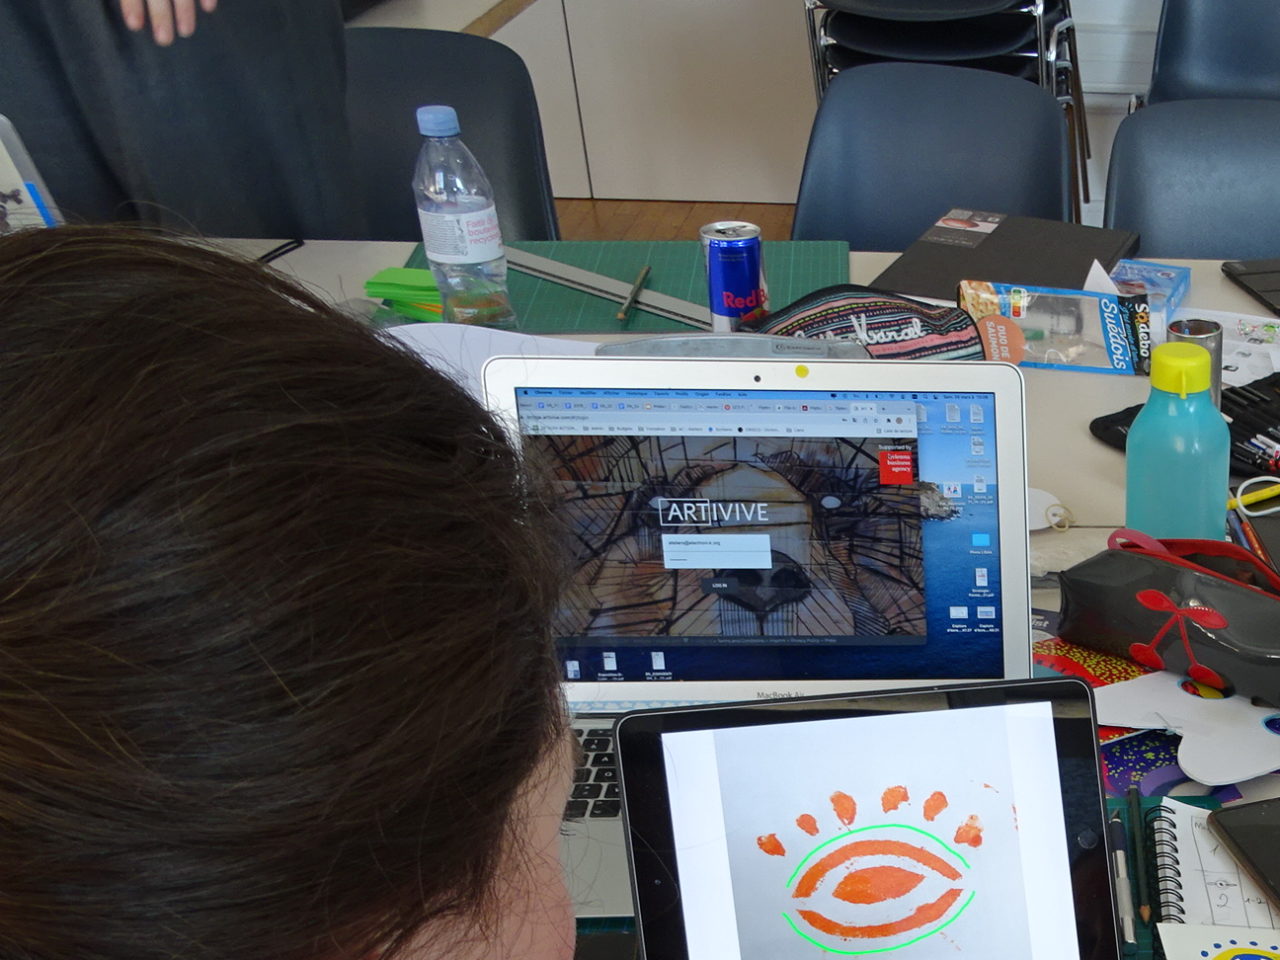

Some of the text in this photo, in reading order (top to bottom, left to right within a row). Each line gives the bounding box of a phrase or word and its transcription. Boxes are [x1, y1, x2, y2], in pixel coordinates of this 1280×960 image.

[723, 289, 756, 308] Red
[986, 321, 1000, 361] SAUMON
[999, 325, 1010, 359] DUO DE
[1101, 298, 1127, 369] Suédois
[1135, 303, 1151, 357] Sodebo
[668, 503, 769, 521] ARTIVIVE
